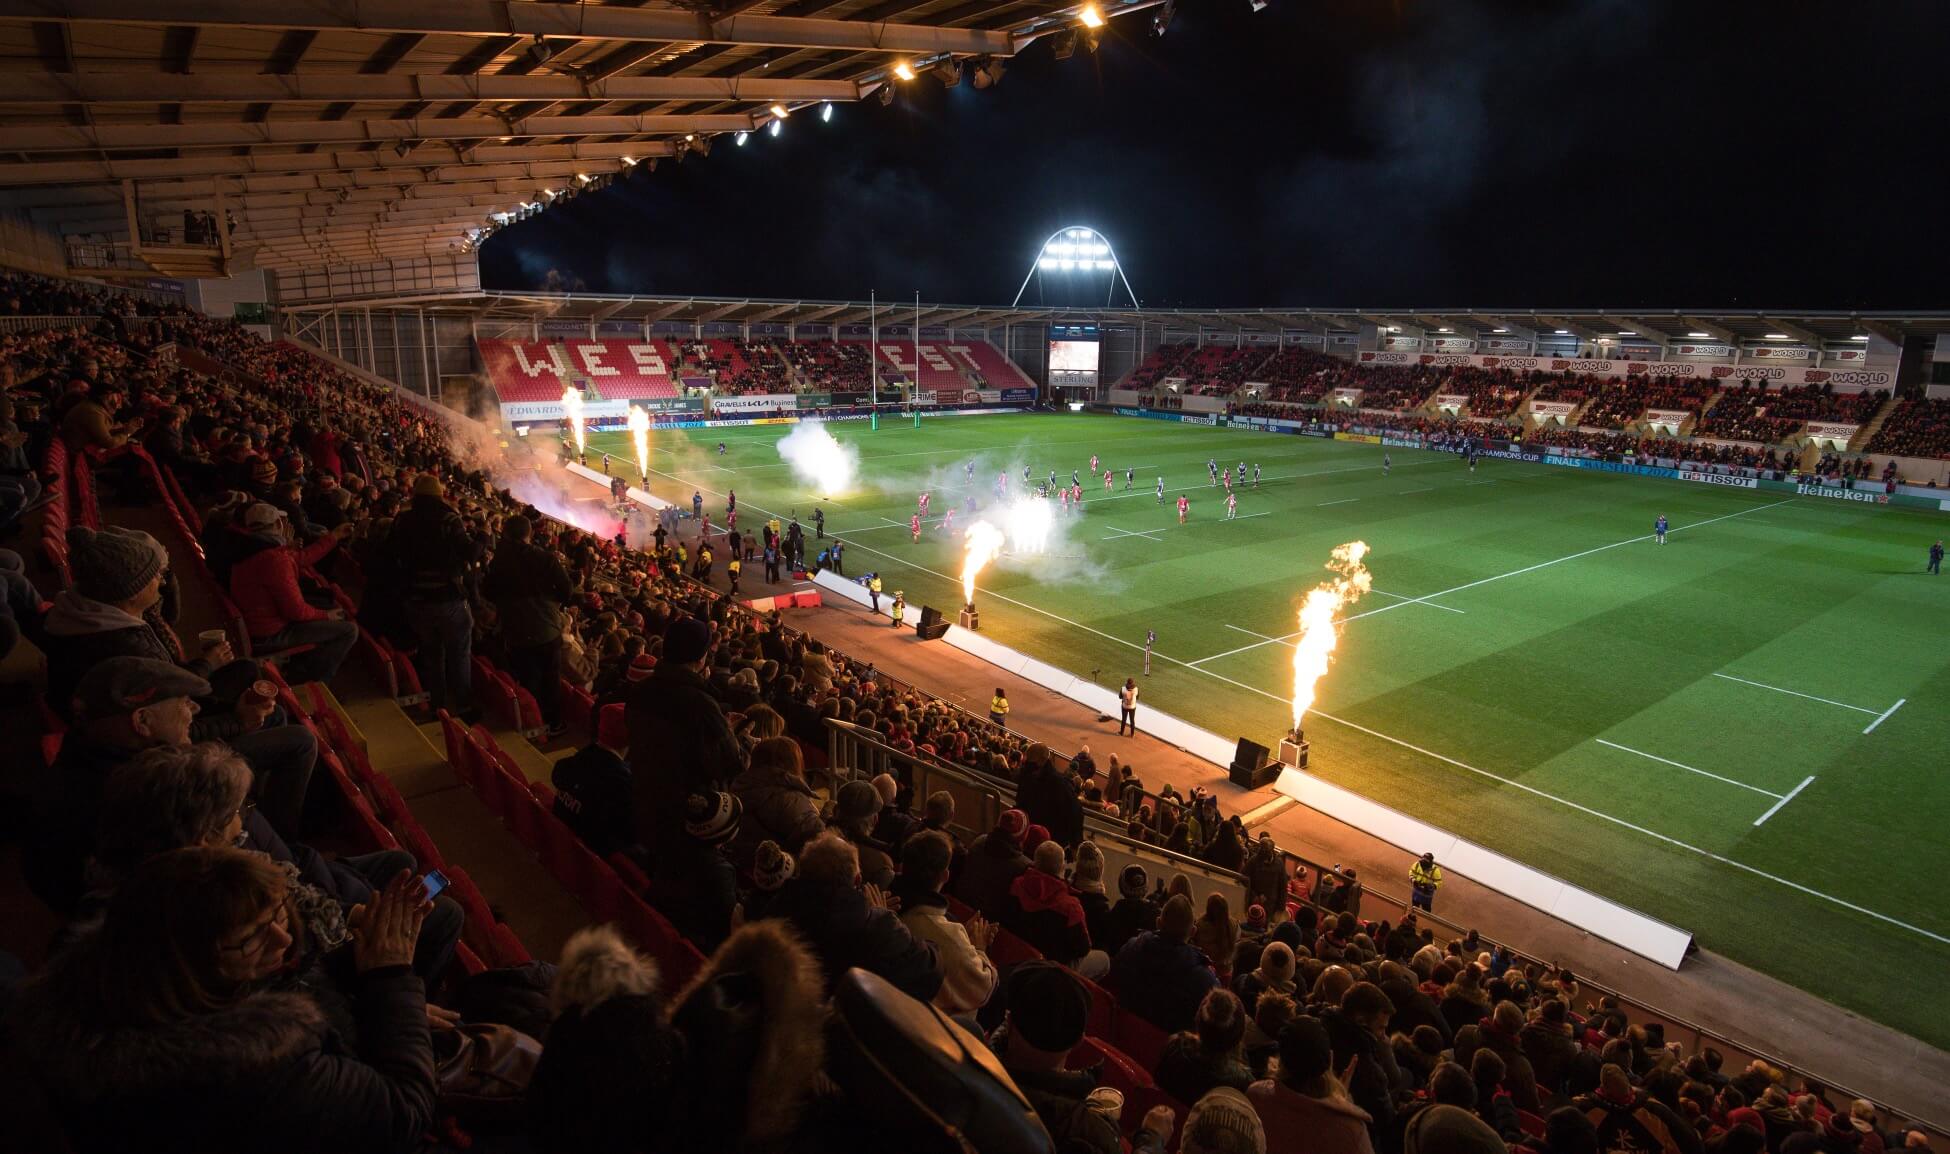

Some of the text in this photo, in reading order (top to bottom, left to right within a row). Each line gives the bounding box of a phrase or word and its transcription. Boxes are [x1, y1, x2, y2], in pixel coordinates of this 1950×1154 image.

[1695, 346, 1727, 354] WORLD
[1772, 349, 1806, 358] WORLD
[1376, 353, 1407, 362] WORLD
[1436, 355, 1470, 365] WORLD
[1501, 358, 1537, 368] WORLD
[1552, 360, 1612, 372] ZIP WORLD
[1627, 363, 1694, 376] ZIP WORLD
[1711, 367, 1785, 379] ZIP WORLD
[1804, 371, 1889, 386] ZIP WORLD
[1053, 375, 1094, 383] STERLING
[510, 406, 564, 415] EDWARDS
[1227, 420, 1260, 431] Heineken
[1382, 437, 1420, 448] Heineken
[1478, 448, 1539, 462] CHAMPIONS CUP
[1546, 455, 1581, 467] FINALS
[1703, 474, 1753, 487] TISSOT
[1796, 483, 1873, 503] Heineken
